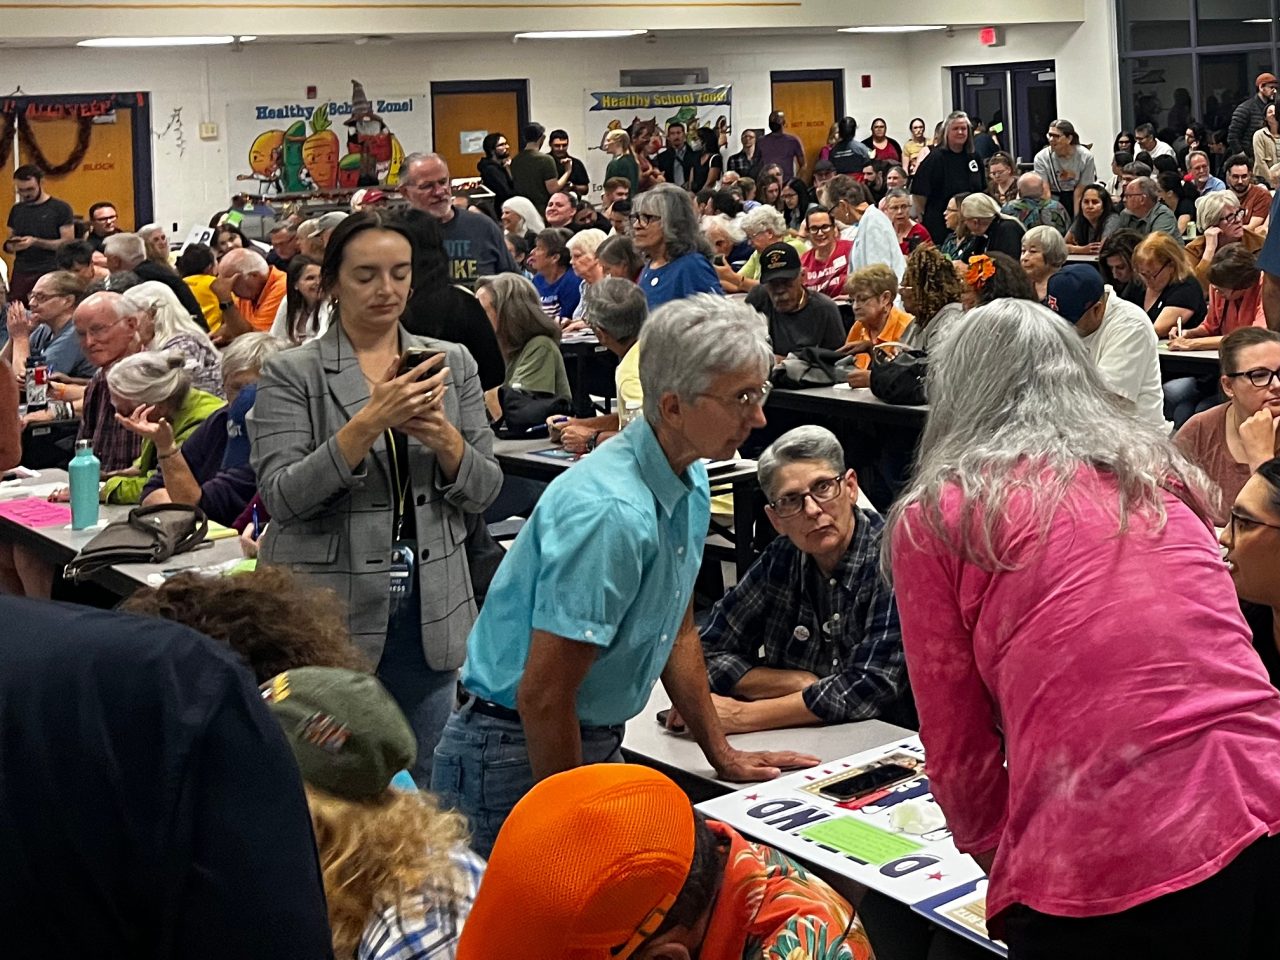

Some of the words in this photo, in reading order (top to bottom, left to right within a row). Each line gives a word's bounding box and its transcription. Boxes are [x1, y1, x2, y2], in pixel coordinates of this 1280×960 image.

[256, 105, 314, 120] Healthy
[377, 99, 413, 113] Zone!
[602, 95, 650, 108] Healthy
[654, 93, 694, 105] School
[746, 797, 942, 879] DND
